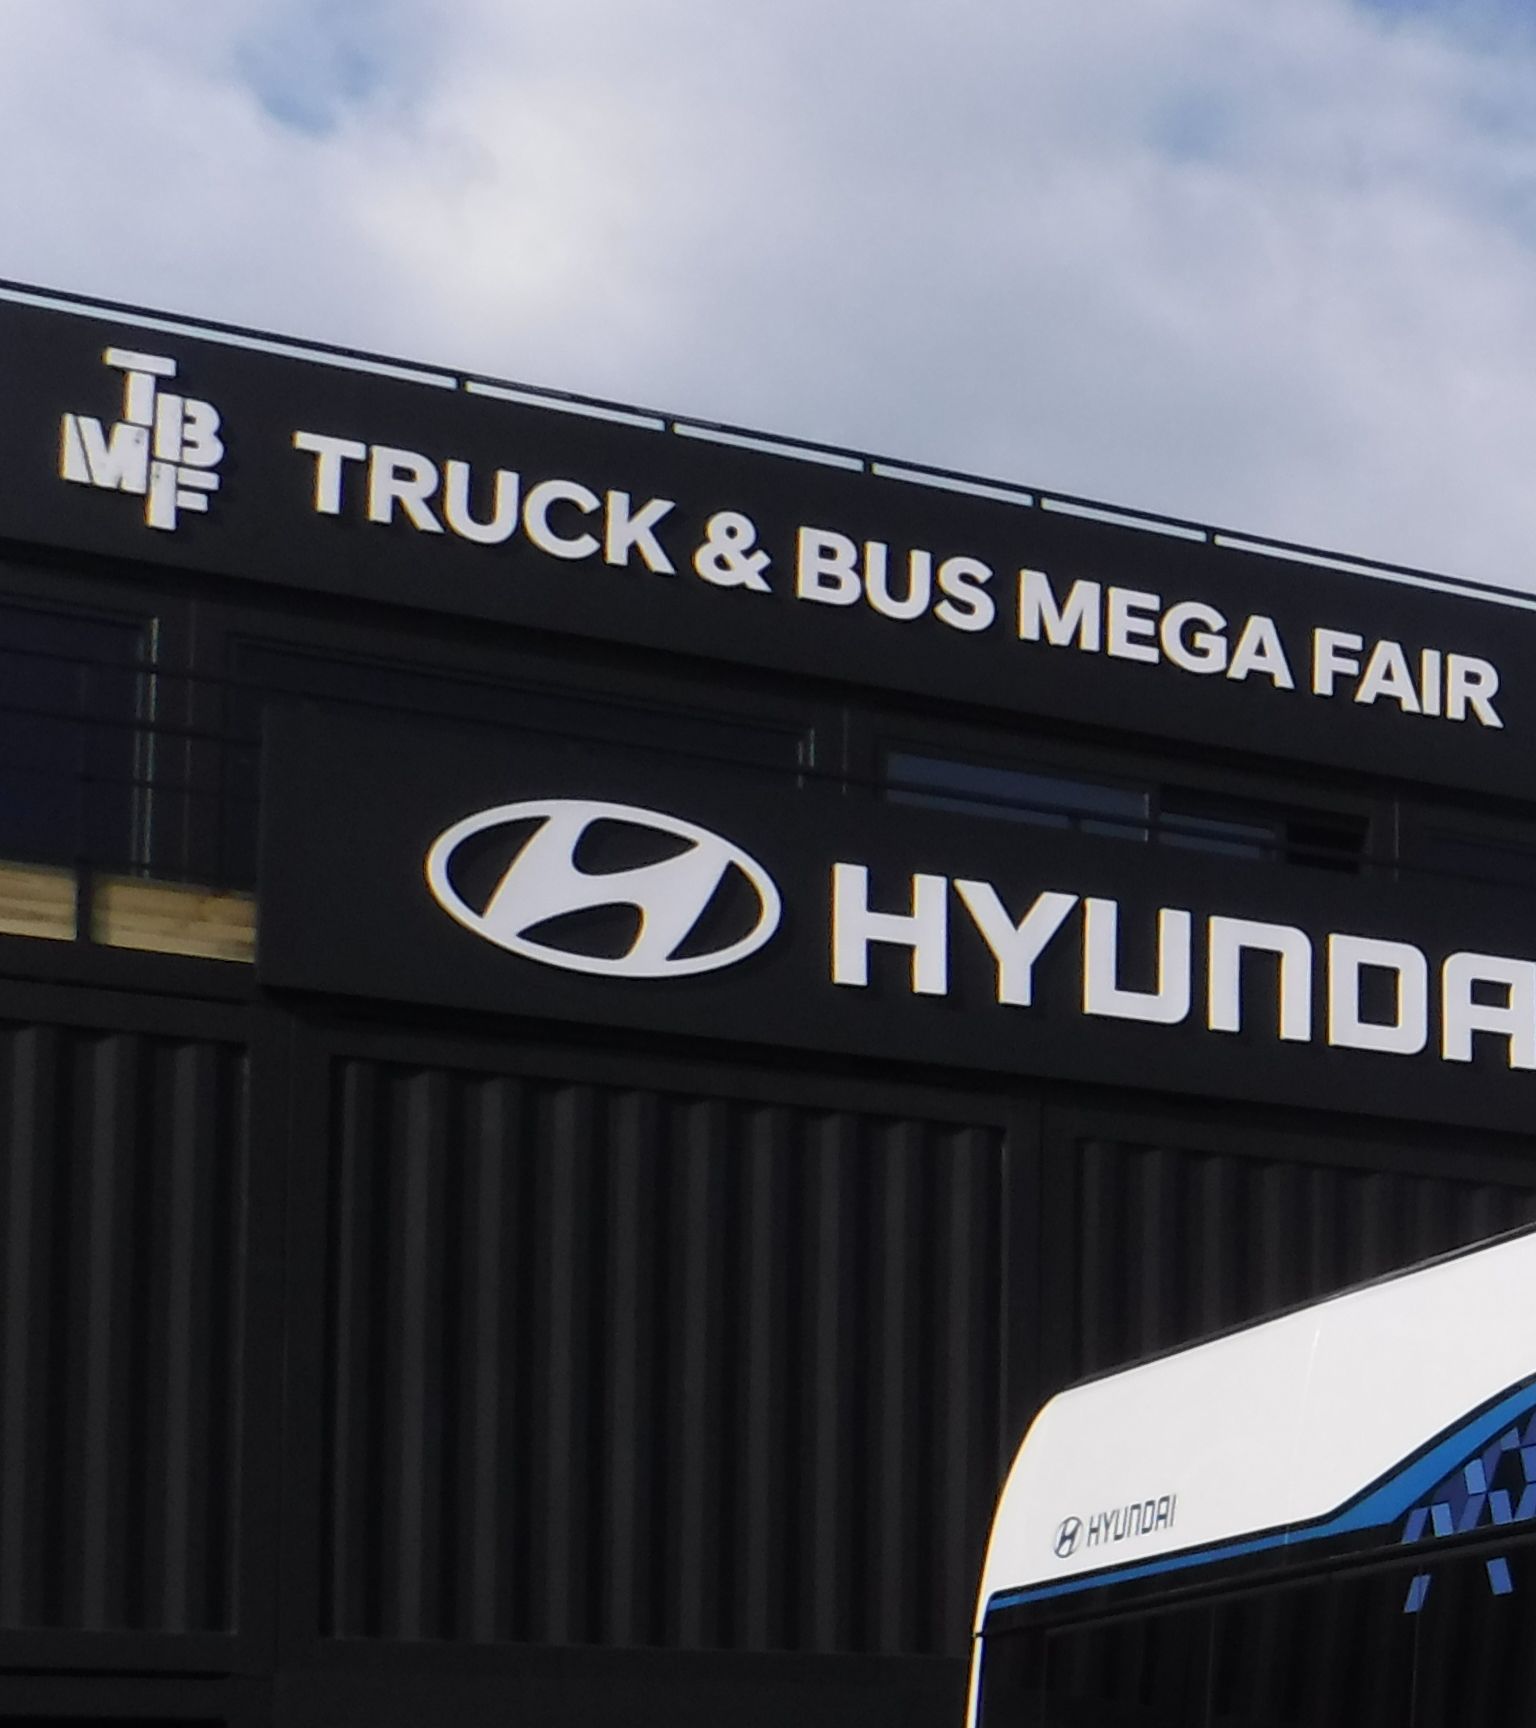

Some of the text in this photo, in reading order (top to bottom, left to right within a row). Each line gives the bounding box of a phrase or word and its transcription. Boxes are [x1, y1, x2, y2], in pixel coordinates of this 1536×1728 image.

[293, 430, 1504, 730] TRUCK & BUS MEGA FAIR
[1086, 1493, 1178, 1547] HYUNDAI
